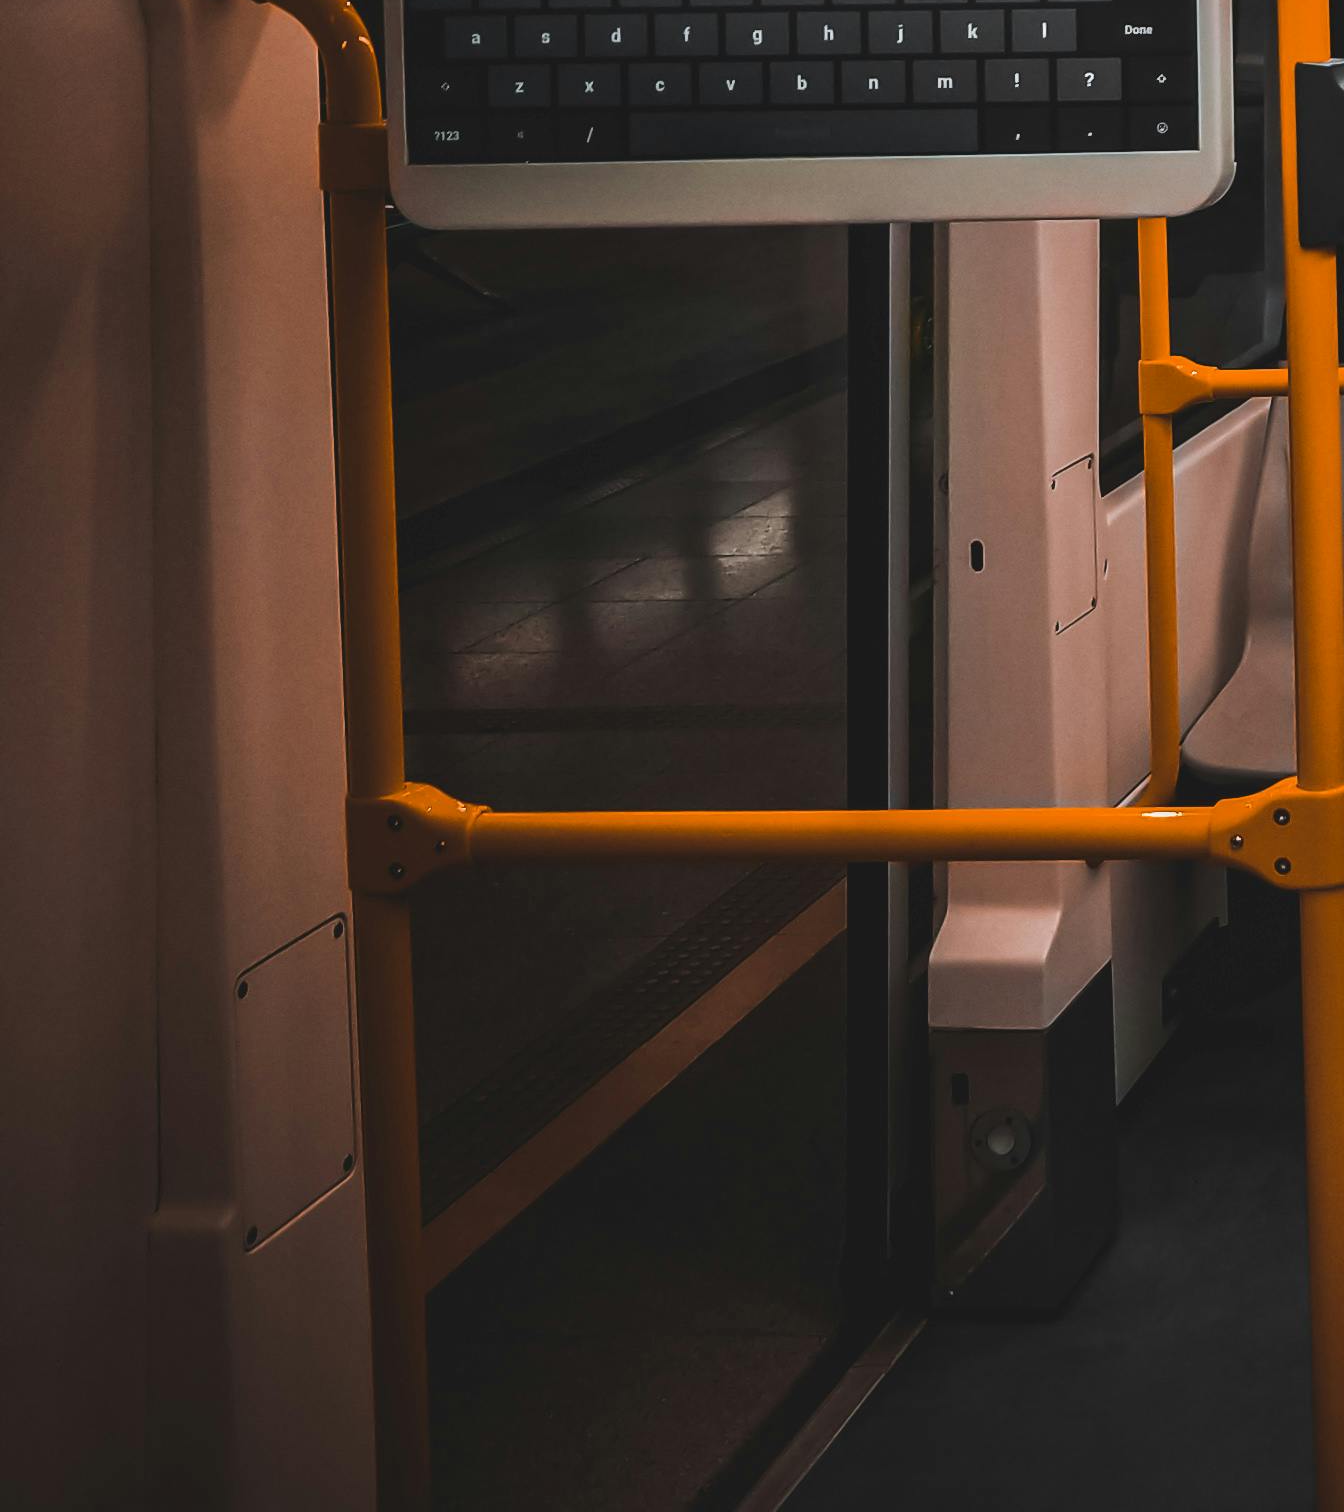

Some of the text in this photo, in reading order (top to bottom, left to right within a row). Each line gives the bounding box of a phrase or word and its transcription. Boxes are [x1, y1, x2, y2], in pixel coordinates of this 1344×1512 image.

[471, 32, 482, 46] a
[540, 31, 551, 45] s
[610, 27, 622, 44] d
[682, 25, 692, 43] f
[751, 28, 764, 46] g
[822, 24, 835, 41] h
[896, 23, 905, 45] j
[967, 22, 979, 40] k
[1124, 24, 1153, 35] Done
[514, 80, 525, 94] z
[584, 80, 595, 93] x
[654, 79, 666, 93] c
[724, 78, 736, 92] v
[796, 74, 808, 91] b
[867, 77, 879, 90] n
[937, 75, 954, 89] m
[1083, 71, 1095, 88] ?
[434, 130, 460, 141] ?123
